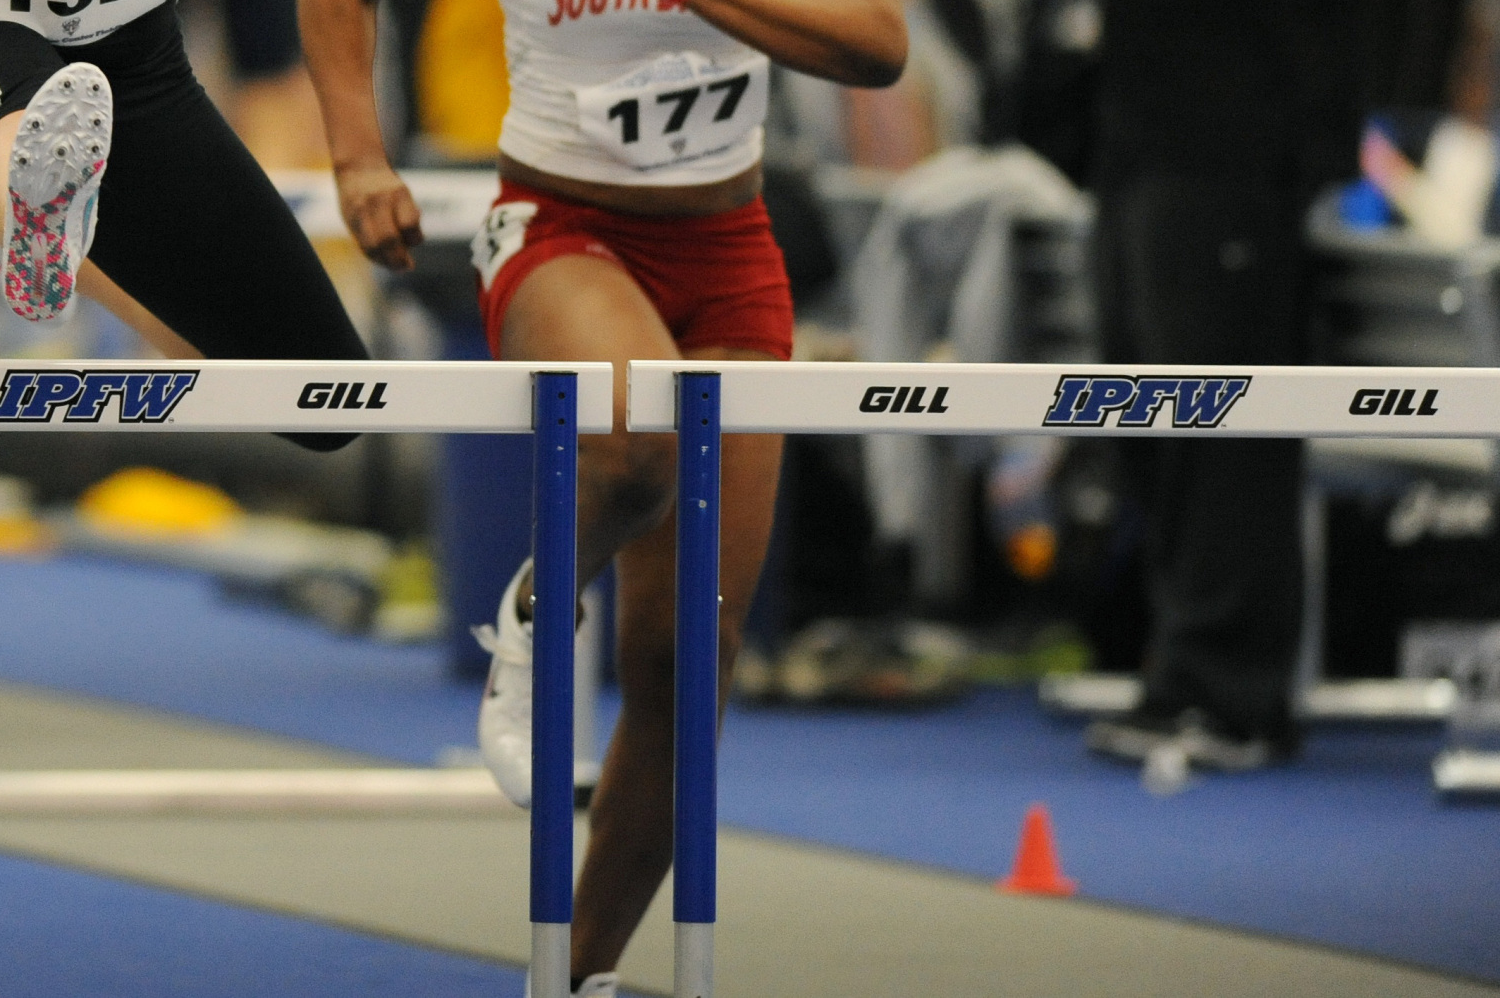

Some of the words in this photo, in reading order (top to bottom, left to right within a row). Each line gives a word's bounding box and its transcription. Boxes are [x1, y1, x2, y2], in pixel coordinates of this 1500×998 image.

[608, 73, 750, 144] 177
[297, 383, 387, 409] GILL
[859, 386, 949, 413] GILL
[1042, 374, 1252, 428] IPFW
[1349, 389, 1439, 415] GILL
